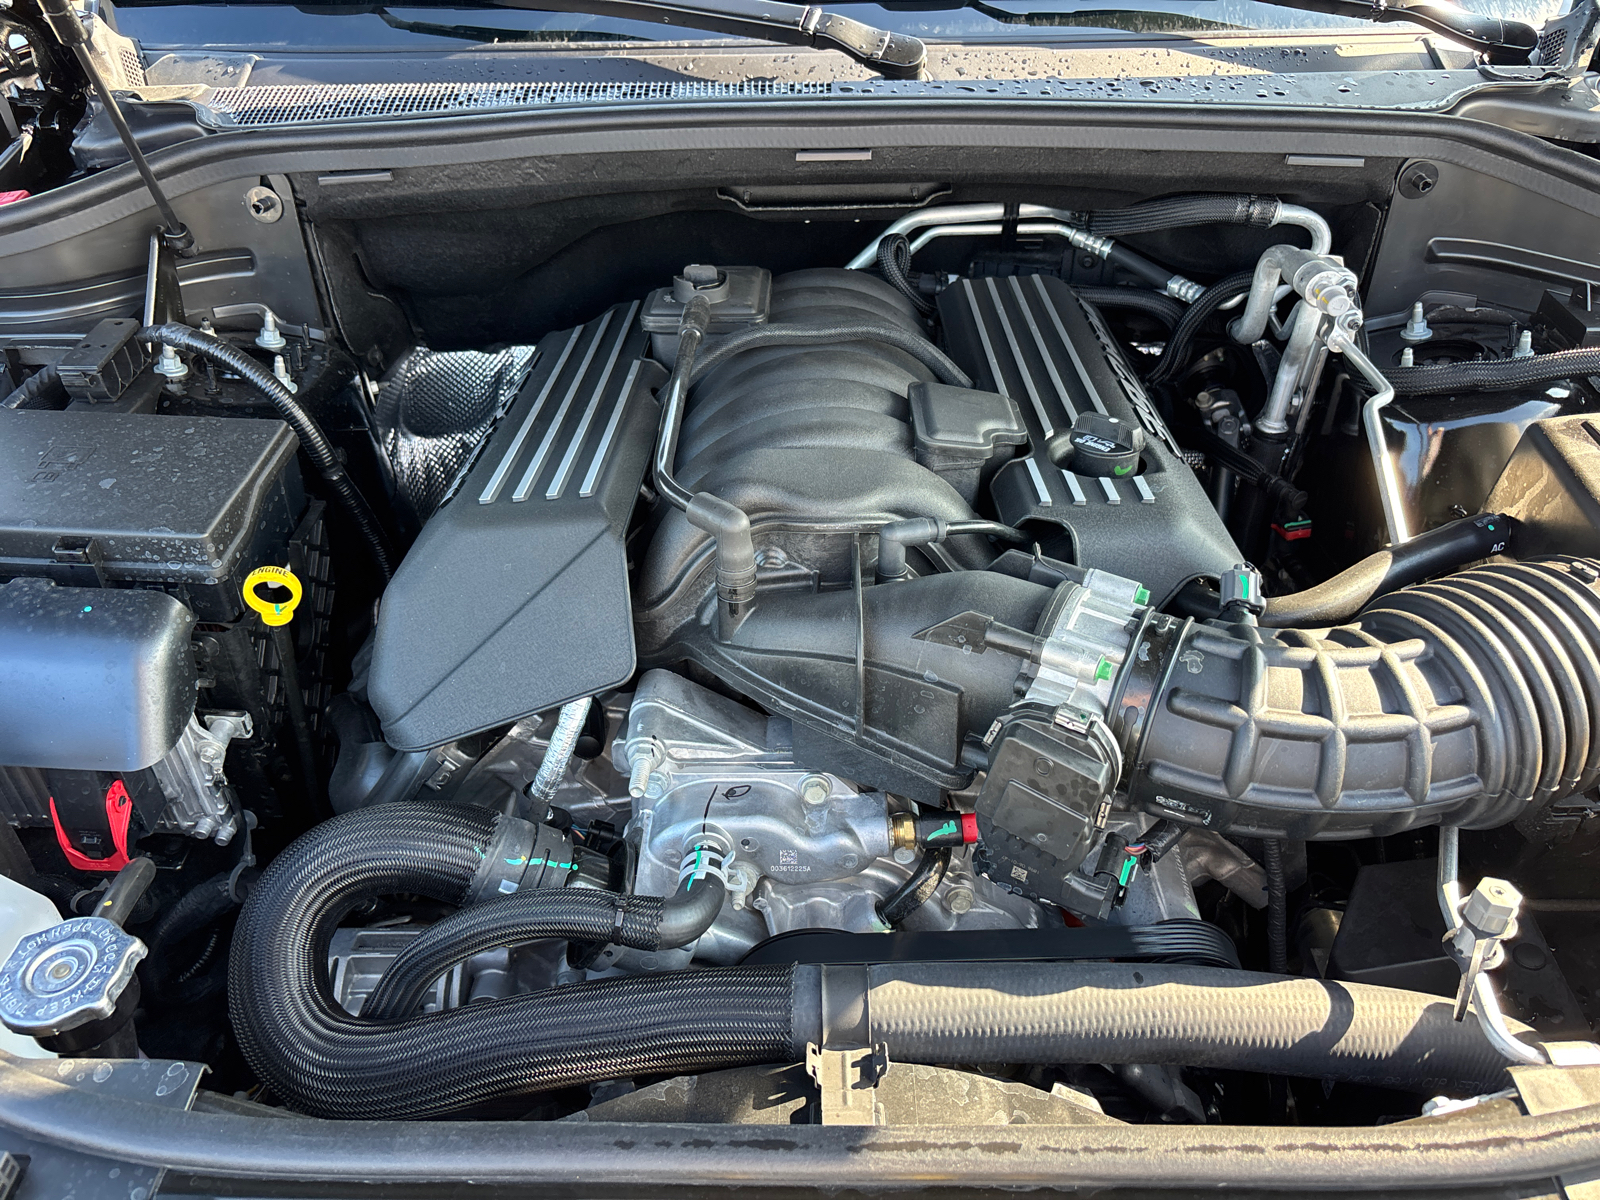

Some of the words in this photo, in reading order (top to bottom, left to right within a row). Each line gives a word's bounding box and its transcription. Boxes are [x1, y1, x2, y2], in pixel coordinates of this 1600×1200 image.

[1490, 541, 1506, 554] AC
[252, 566, 289, 578] ENGINE
[92, 964, 114, 975] TVS
[35, 989, 84, 1017] KEEP
